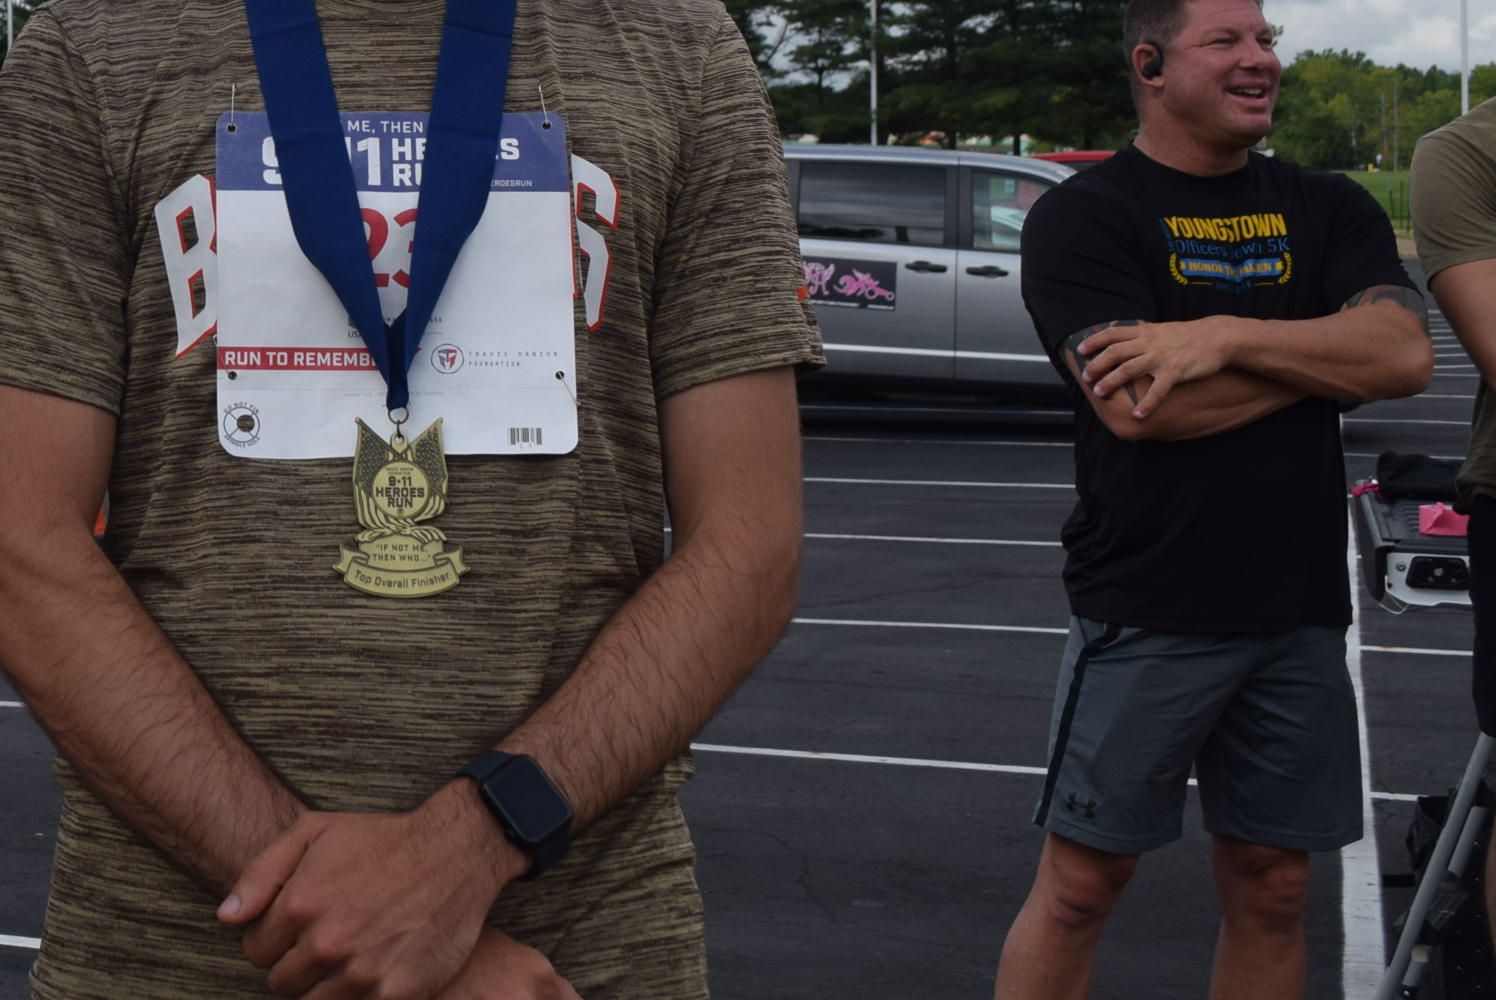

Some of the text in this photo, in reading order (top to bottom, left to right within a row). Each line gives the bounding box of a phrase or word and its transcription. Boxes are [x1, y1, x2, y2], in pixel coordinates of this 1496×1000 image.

[347, 120, 424, 133] ME, THEN
[1164, 213, 1287, 243] YOUNGSTOWN
[1267, 237, 1290, 253] 5K
[225, 352, 376, 367] RUN TO REMEMB
[375, 487, 425, 497] HEROES
[387, 498, 414, 508] RUN
